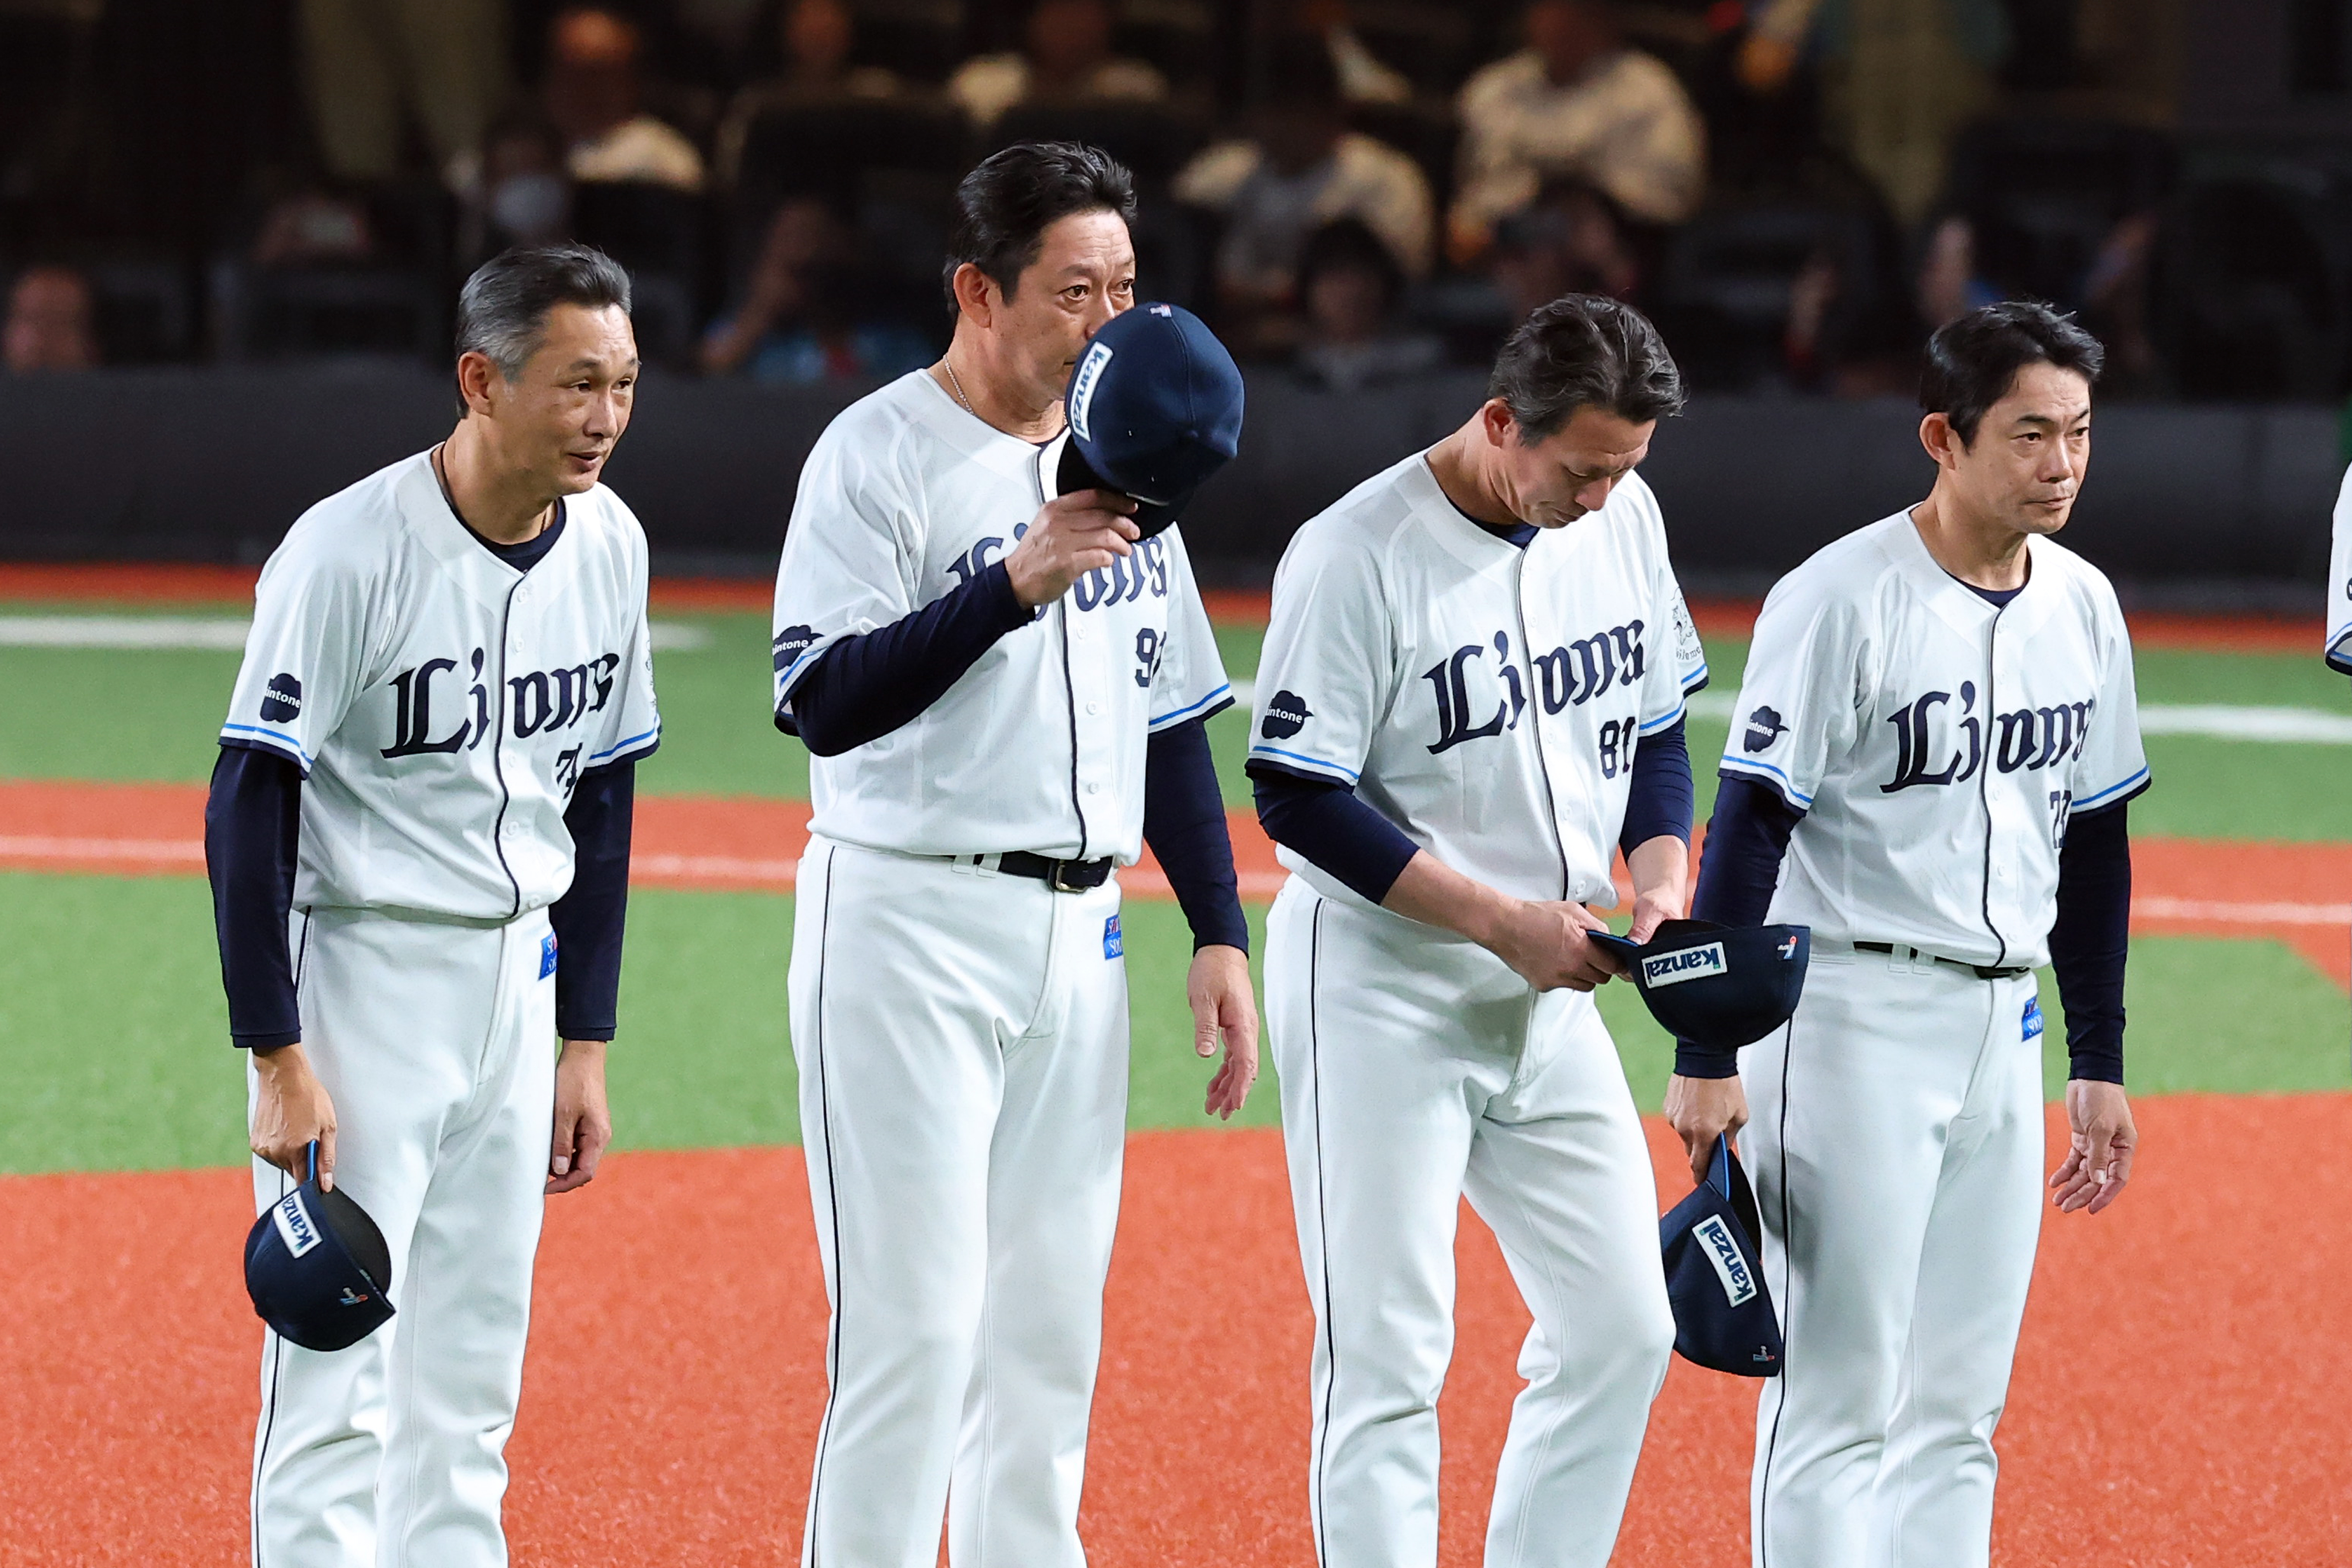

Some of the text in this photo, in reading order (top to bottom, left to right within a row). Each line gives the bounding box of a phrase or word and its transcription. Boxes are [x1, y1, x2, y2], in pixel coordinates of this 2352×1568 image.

[266, 686, 301, 708] intone
[380, 646, 620, 759] Lions
[1267, 706, 1302, 723] intone
[1421, 619, 1646, 755] Lions
[281, 1196, 314, 1251] kanza
